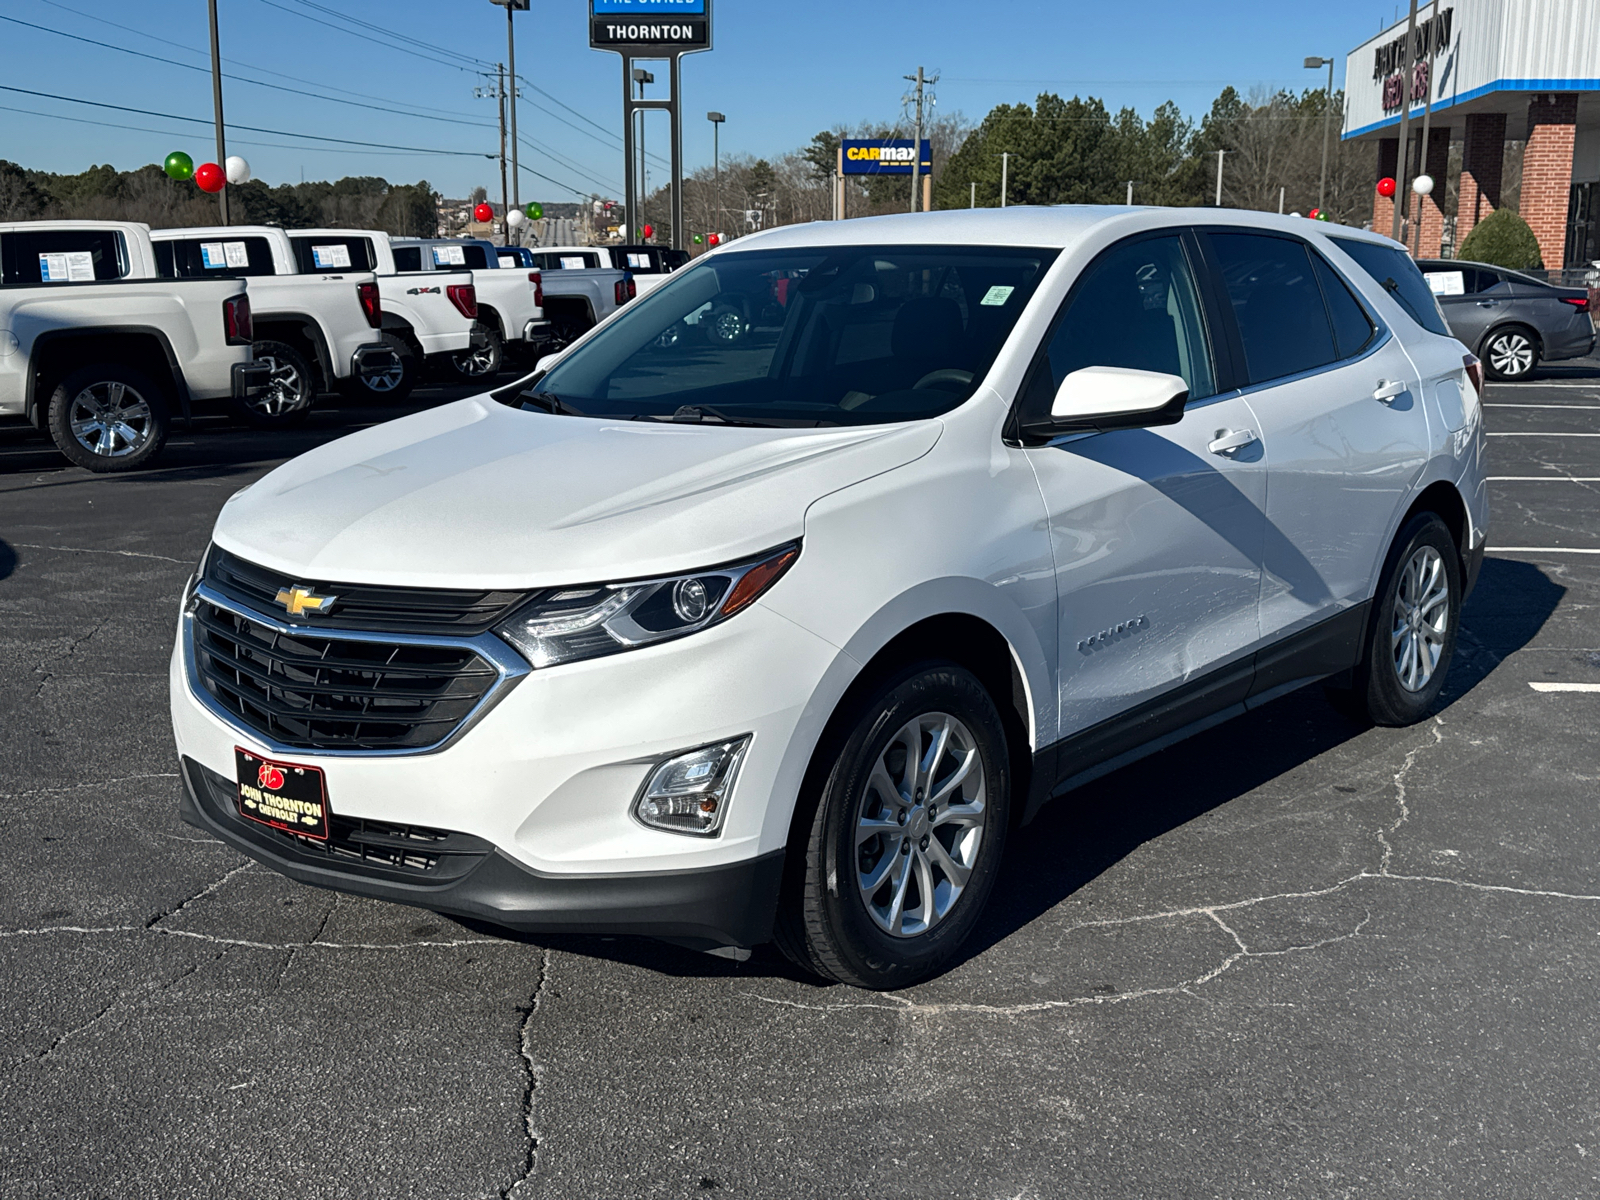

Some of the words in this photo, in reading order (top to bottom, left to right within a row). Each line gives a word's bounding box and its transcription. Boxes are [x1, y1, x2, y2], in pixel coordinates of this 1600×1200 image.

[607, 25, 693, 39] THORNTON
[240, 783, 262, 803] JOHN
[263, 792, 322, 817] THORNTON
[258, 803, 299, 823] CHEVROLET
